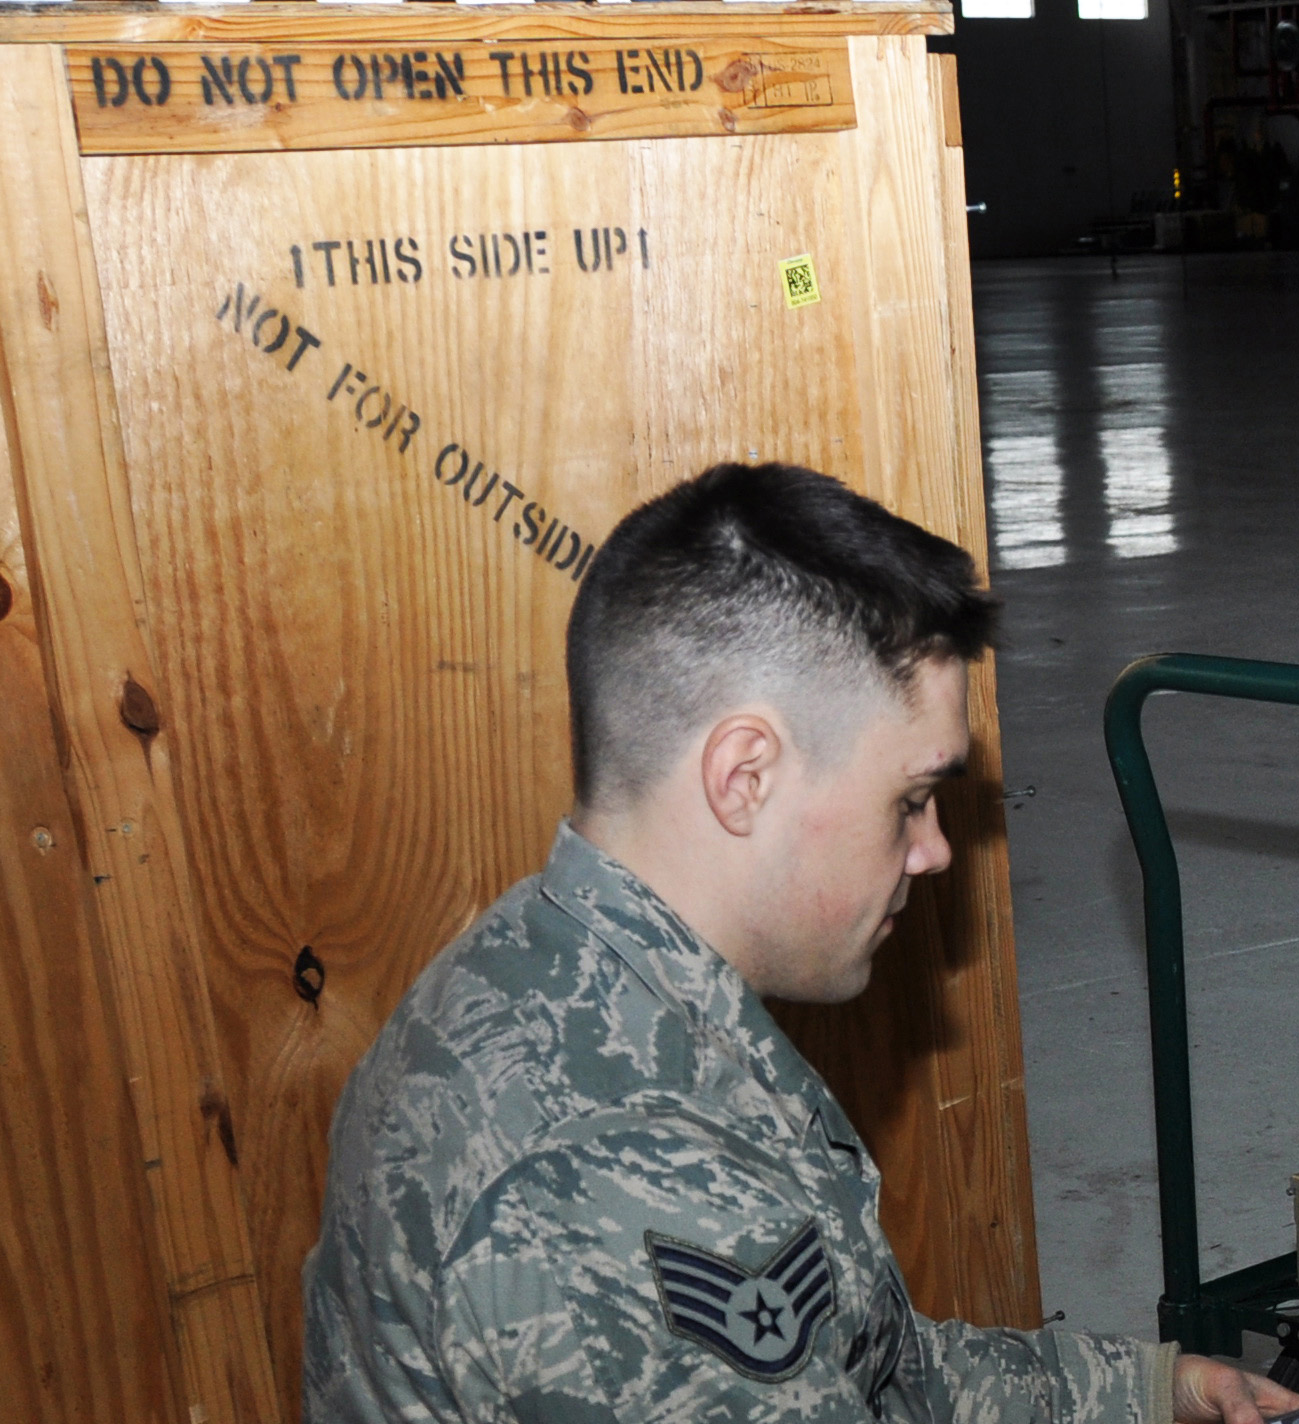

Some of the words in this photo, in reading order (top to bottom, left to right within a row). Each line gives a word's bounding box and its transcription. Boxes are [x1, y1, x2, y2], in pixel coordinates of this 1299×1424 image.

[91, 56, 171, 107] DO
[200, 55, 301, 105] NOT
[332, 51, 464, 101] OPEN
[489, 50, 593, 97] THIS
[616, 48, 703, 94] END
[312, 237, 422, 287] THIS
[449, 231, 549, 278] SIDE
[574, 227, 627, 272] UP
[216, 282, 321, 371] NOT
[327, 363, 420, 453] FOR
